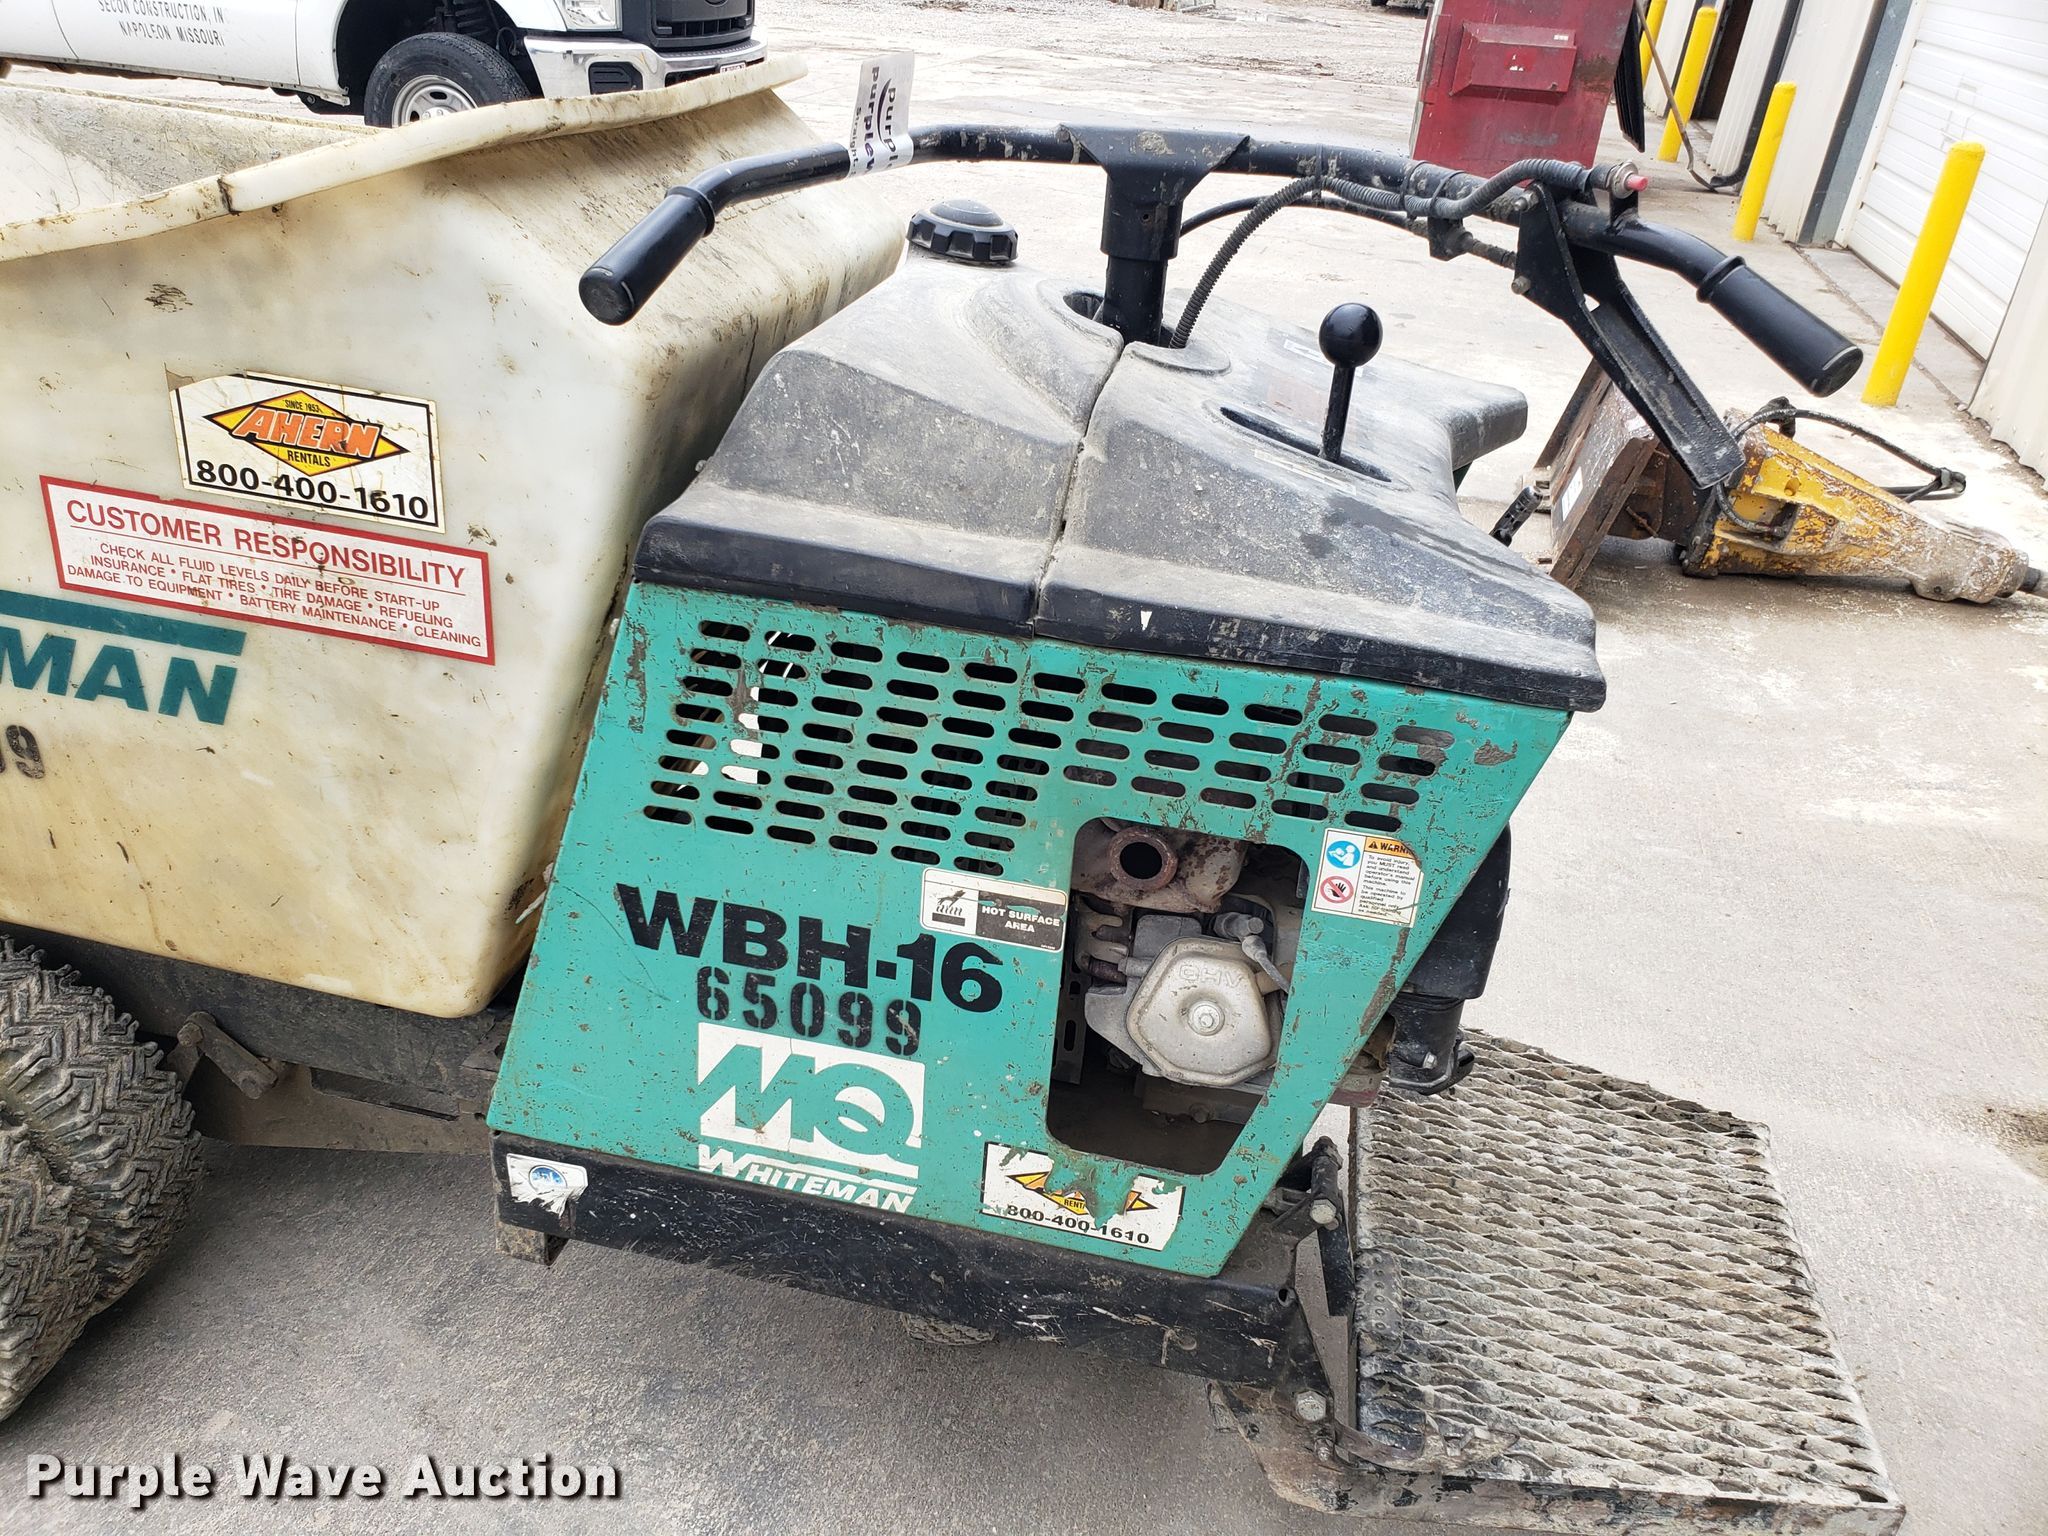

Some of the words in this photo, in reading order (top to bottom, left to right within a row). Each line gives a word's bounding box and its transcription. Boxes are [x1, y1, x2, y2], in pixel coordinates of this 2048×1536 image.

[98, 0, 130, 14] SECON
[118, 20, 172, 40] NAPOLEON
[232, 406, 382, 459] AHERN
[287, 449, 331, 468] RENTALS
[197, 459, 428, 519] 800-400-1610
[66, 499, 222, 547] CUSTOMER
[234, 528, 465, 588] RESPONSIBILITY
[67, 564, 121, 584] DAMAGE
[126, 574, 143, 587] TO
[149, 579, 222, 601] EQUIPMENT
[240, 594, 297, 614] BATTERY
[302, 605, 397, 631] MAINTENANCE
[414, 625, 481, 647] CLEANING
[91, 554, 165, 578] INSURANCE
[182, 571, 212, 586] FLAT
[217, 577, 256, 594] TIRES
[272, 587, 300, 601] TIRE
[306, 592, 361, 612] DAMAGE
[379, 605, 453, 628] REFUELING
[100, 542, 145, 561] CHECK
[151, 552, 174, 566] ALL
[179, 556, 215, 572] FLUID
[220, 563, 270, 582] LEVELS
[275, 573, 309, 589] DAILY
[315, 580, 368, 599] BEFORE
[374, 590, 440, 611] START-UP
[616, 882, 1004, 1013] WBH-16
[981, 905, 1006, 917] HOT
[1008, 910, 1061, 927] SURFACE
[1004, 919, 1035, 933] AREA
[696, 965, 922, 1057] 65099
[698, 1038, 922, 1166] MQ
[698, 1143, 914, 1214] WHITEMAN
[1007, 1204, 1150, 1244] 800-400-1610
